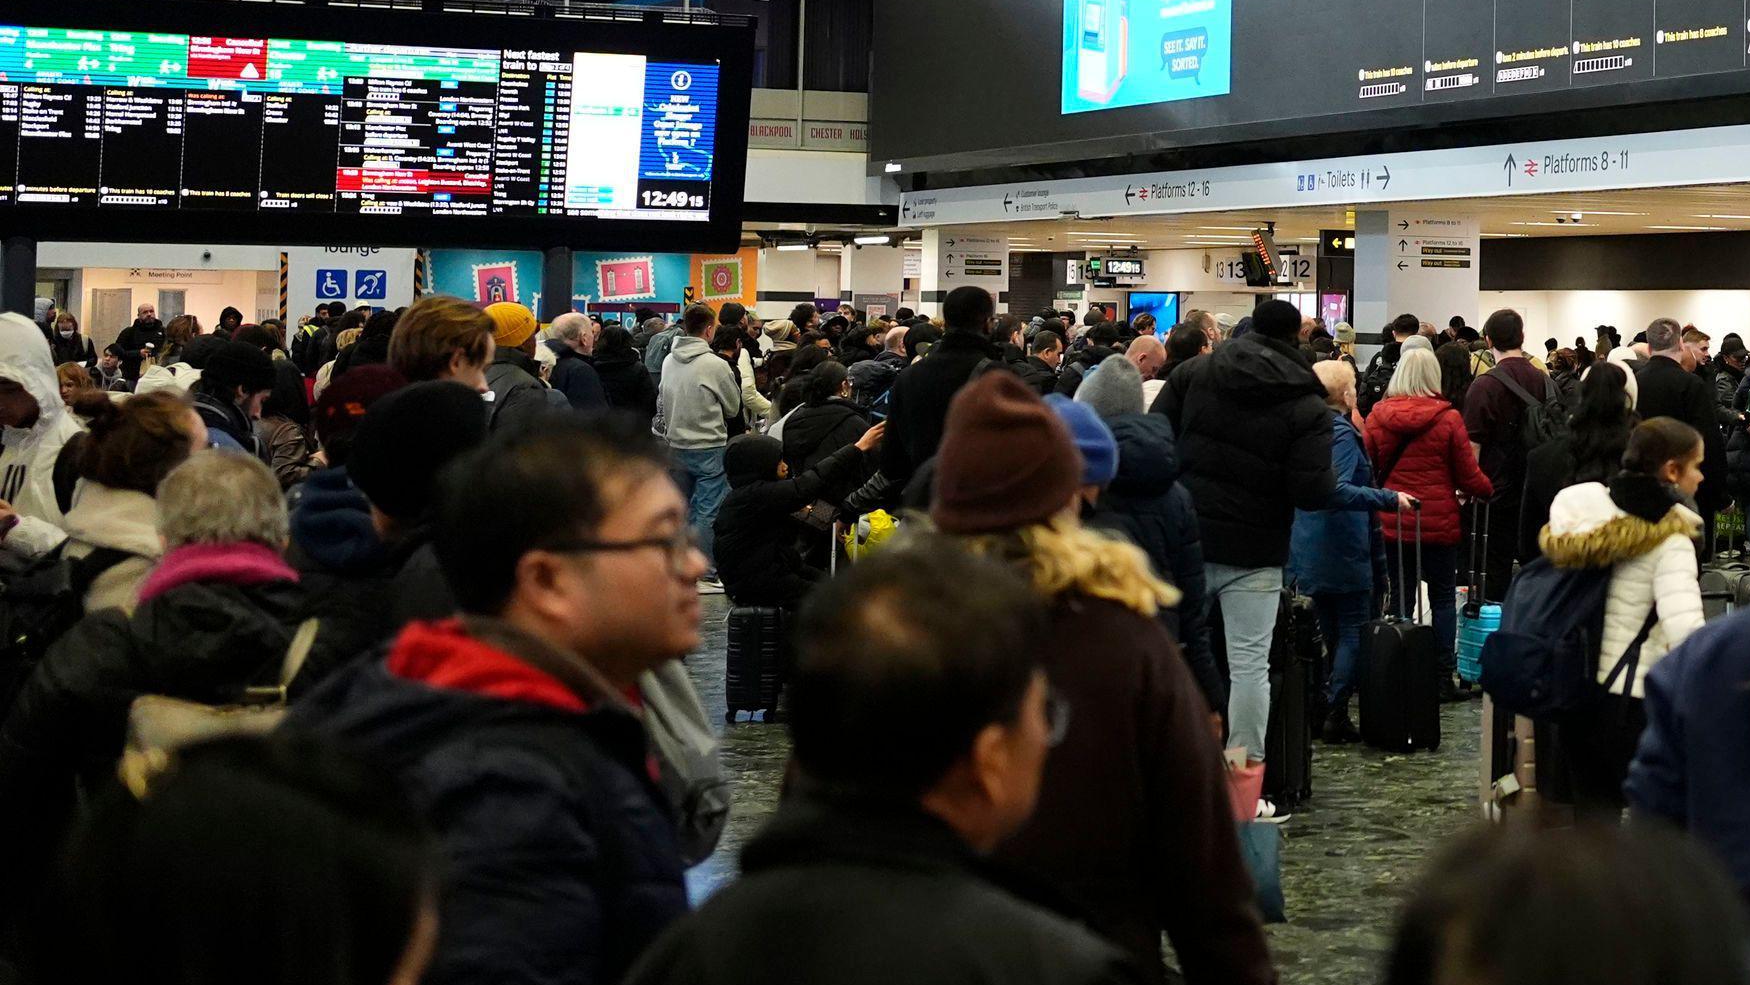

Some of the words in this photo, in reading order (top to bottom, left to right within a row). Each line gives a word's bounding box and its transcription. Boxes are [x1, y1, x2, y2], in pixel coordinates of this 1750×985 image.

[503, 50, 525, 59] Next
[527, 51, 560, 61] fastest
[502, 61, 525, 70] train
[527, 62, 537, 70] to
[751, 125, 793, 138] BLACKPOOL
[811, 128, 843, 140] CHESTER
[1544, 153, 1598, 174] Platforms
[1600, 151, 1609, 170] 8
[1620, 149, 1628, 169] 11
[1326, 171, 1355, 189] Toilets
[1151, 182, 1186, 199] Platforms
[1188, 182, 1196, 197] 12
[1201, 180, 1210, 196] 16
[642, 191, 687, 206] 12:49
[688, 195, 703, 206] 15
[1108, 260, 1131, 273] 12:49
[1227, 261, 1244, 279] 13
[1291, 259, 1310, 278] 12
[149, 271, 175, 279] Meeting
